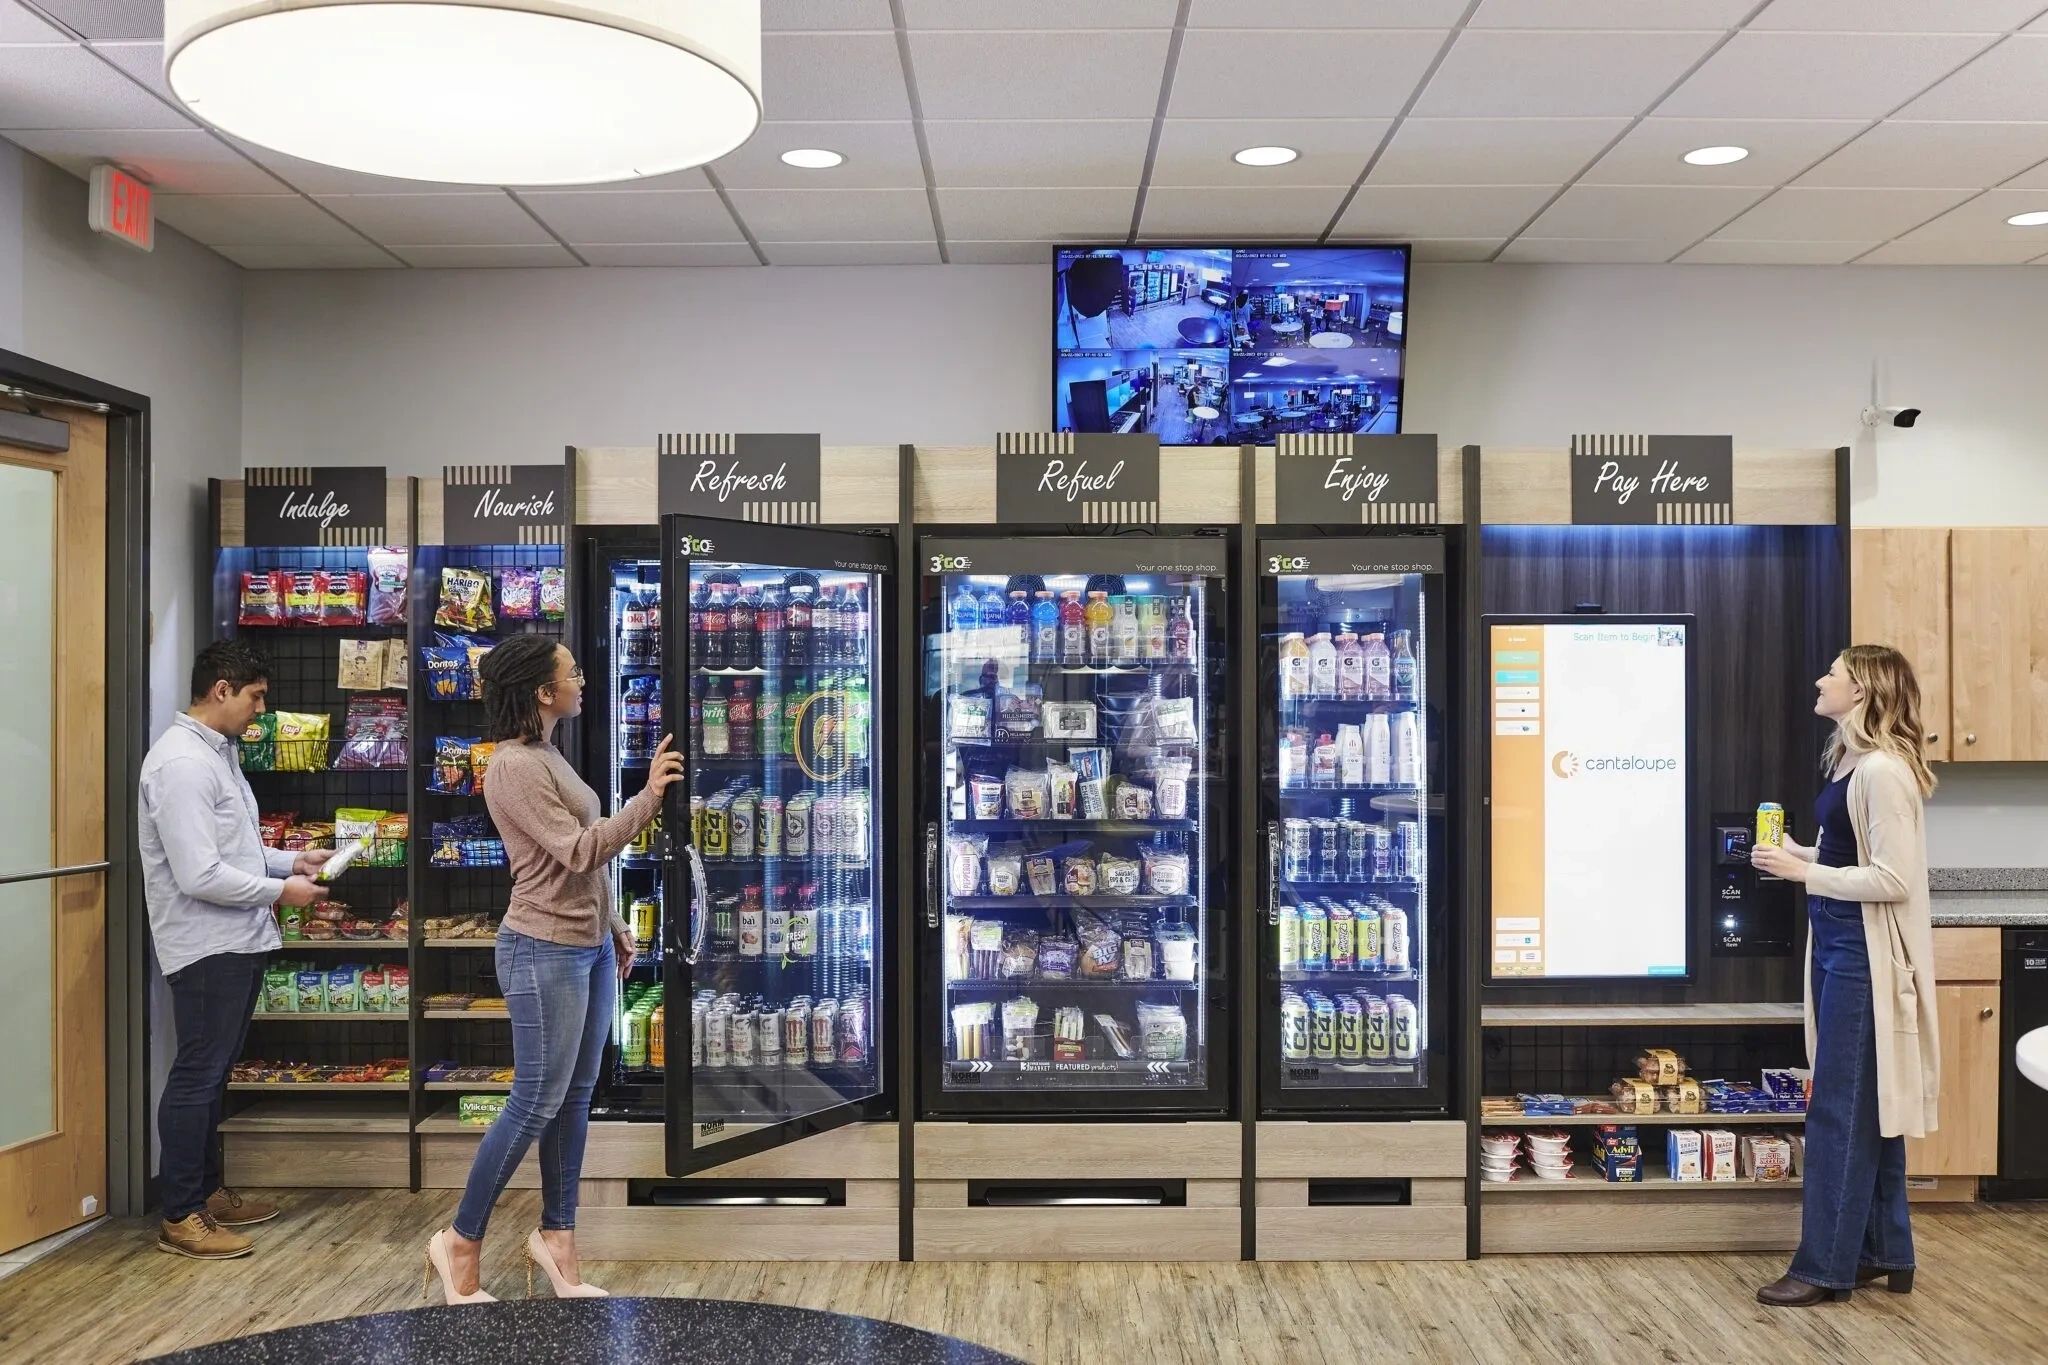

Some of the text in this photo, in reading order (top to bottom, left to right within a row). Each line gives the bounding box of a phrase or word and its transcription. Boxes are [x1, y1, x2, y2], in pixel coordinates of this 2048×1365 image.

[112, 171, 152, 249] EXIT
[689, 460, 787, 503] Refresh
[1037, 459, 1125, 502] Refuel
[1324, 457, 1390, 502] Enjoy
[1593, 459, 1710, 505] Pay Here
[278, 490, 351, 529] Indulge
[473, 488, 556, 519] Nourish
[833, 560, 848, 568] Your
[860, 562, 873, 571] stop
[1135, 564, 1155, 572] Your
[1175, 564, 1194, 572] stop
[1352, 563, 1371, 571] Your
[1391, 563, 1410, 572] stop
[447, 578, 480, 589] HARIBO
[1573, 632, 1657, 643] Scan Item to Begin
[427, 660, 459, 670] Doritos
[442, 746, 471, 755] Doritos
[1585, 753, 1677, 773] cantaloupe
[707, 812, 722, 848] C4
[786, 931, 806, 942] FRESH
[791, 941, 808, 950] NEW
[1092, 944, 1118, 959] BIG
[1099, 953, 1116, 965] AZ
[1293, 1016, 1307, 1051] C4
[1318, 1016, 1332, 1051] C4
[1342, 1016, 1357, 1051] C4
[1370, 1016, 1385, 1051] C4
[1396, 1016, 1410, 1051] C4
[1055, 1063, 1090, 1071] FEATURED
[1289, 1068, 1319, 1077] NORM
[463, 1102, 504, 1112] Mike Ike
[1611, 1145, 1636, 1153] Advil
[1680, 1141, 1698, 1149] SNACK
[1715, 1141, 1733, 1149] SNACK
